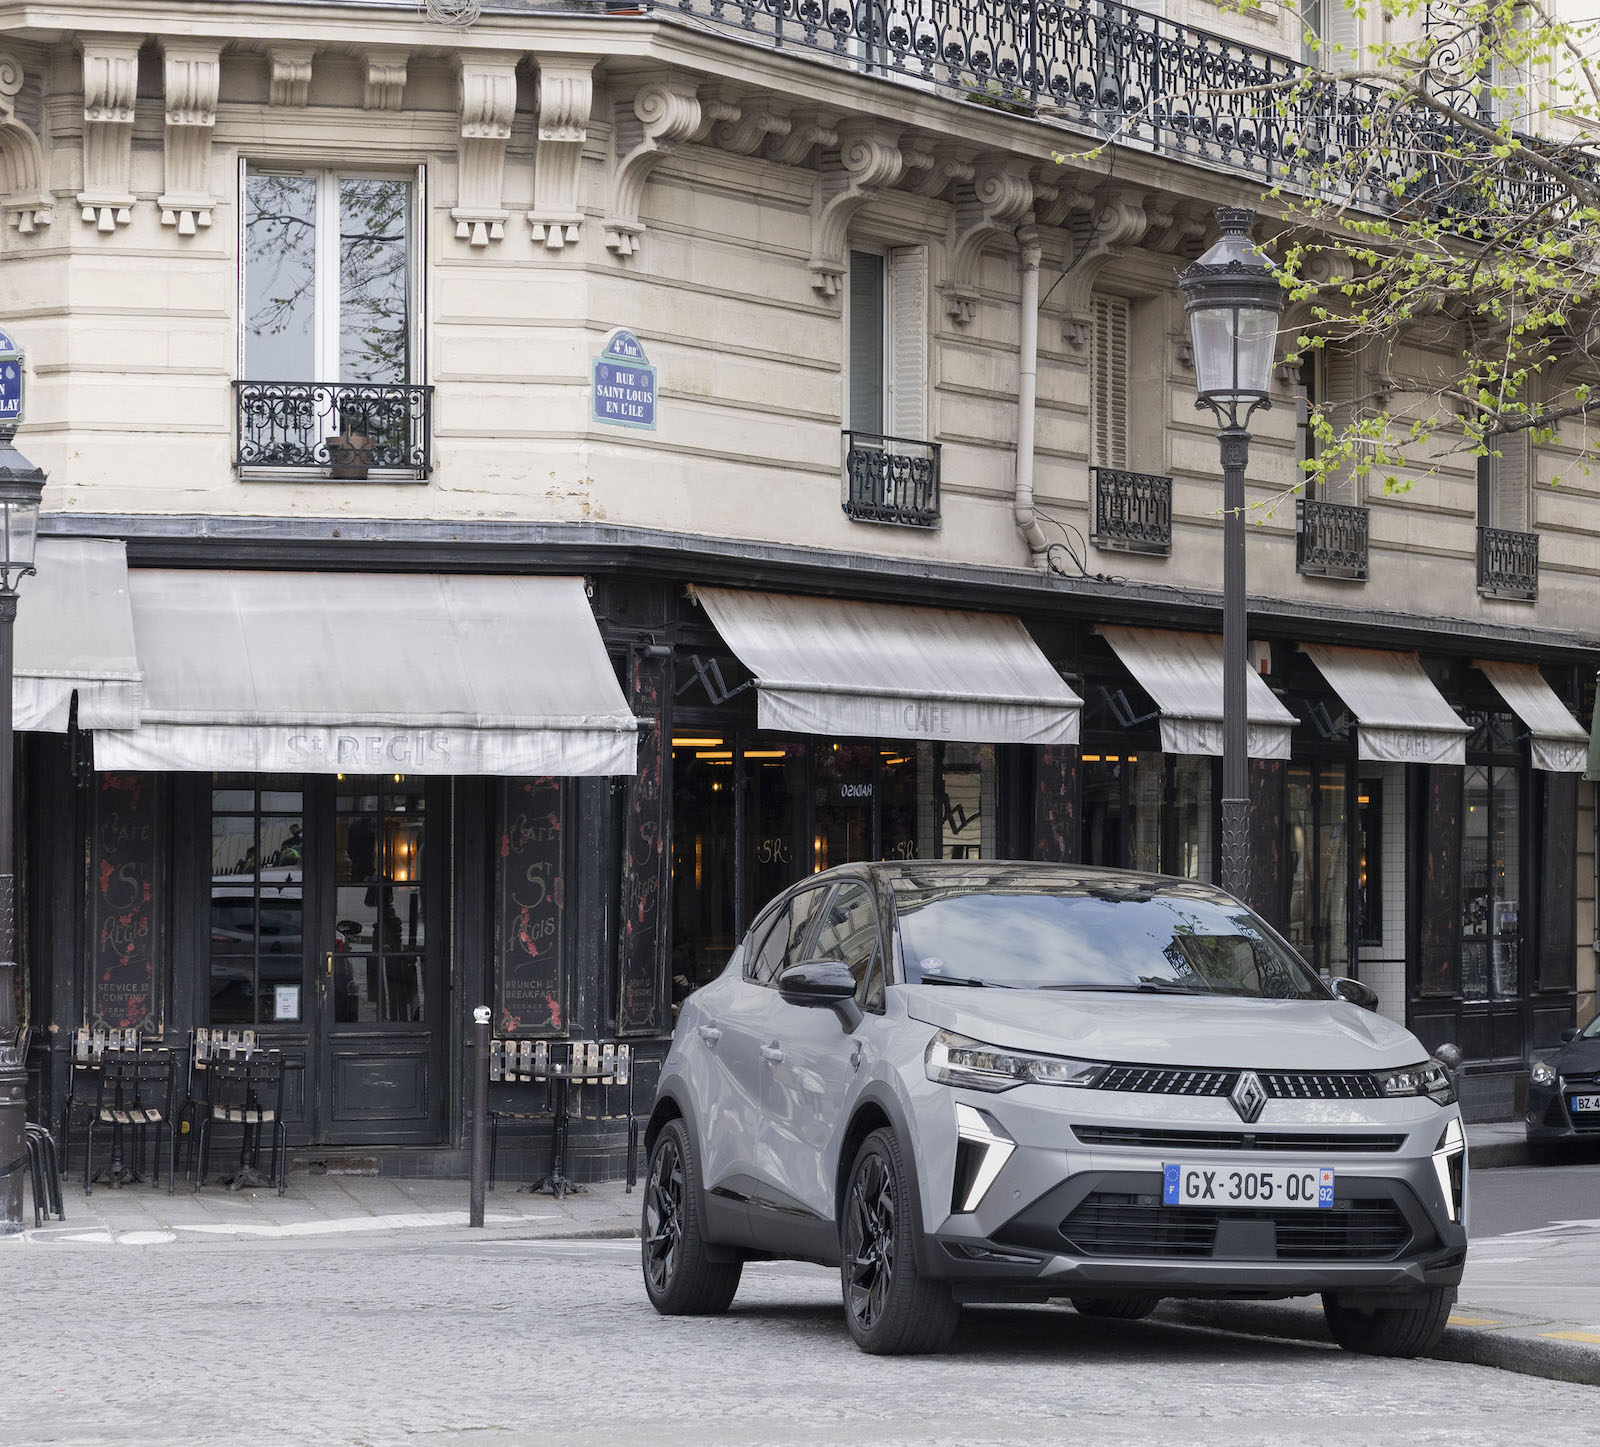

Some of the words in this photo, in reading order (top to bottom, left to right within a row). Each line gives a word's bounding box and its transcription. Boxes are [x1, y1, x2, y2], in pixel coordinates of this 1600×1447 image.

[616, 372, 635, 385] RUE
[597, 385, 624, 399] SAINT
[626, 389, 653, 404] LOUIS
[606, 401, 619, 414] EN
[337, 736, 451, 766] REGIS
[97, 983, 138, 992] SERVICE
[505, 980, 543, 990] BRUNCH
[1169, 1185, 1176, 1194] F
[1185, 1171, 1315, 1202] GX-305-QC
[1319, 1187, 1333, 1202] 92
